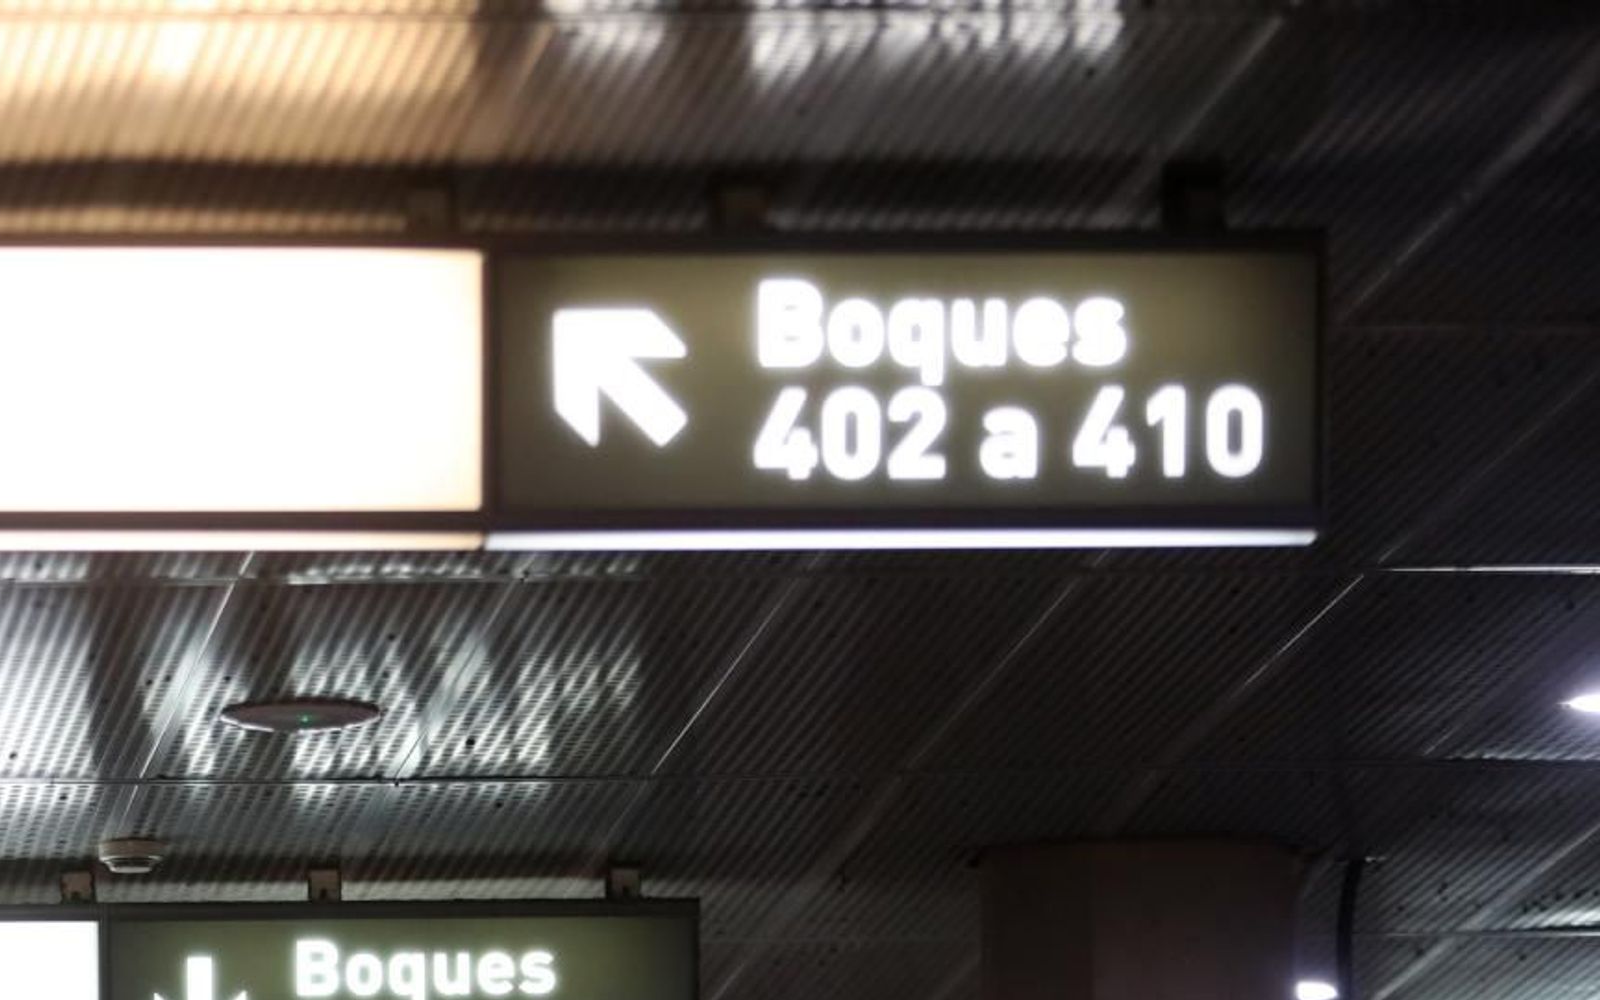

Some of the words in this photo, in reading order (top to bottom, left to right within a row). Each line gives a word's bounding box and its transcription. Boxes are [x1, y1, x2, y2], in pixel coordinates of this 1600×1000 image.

[756, 279, 1128, 385] Boques
[754, 386, 947, 479] 402
[980, 406, 1039, 478] a
[1072, 384, 1263, 478] 410
